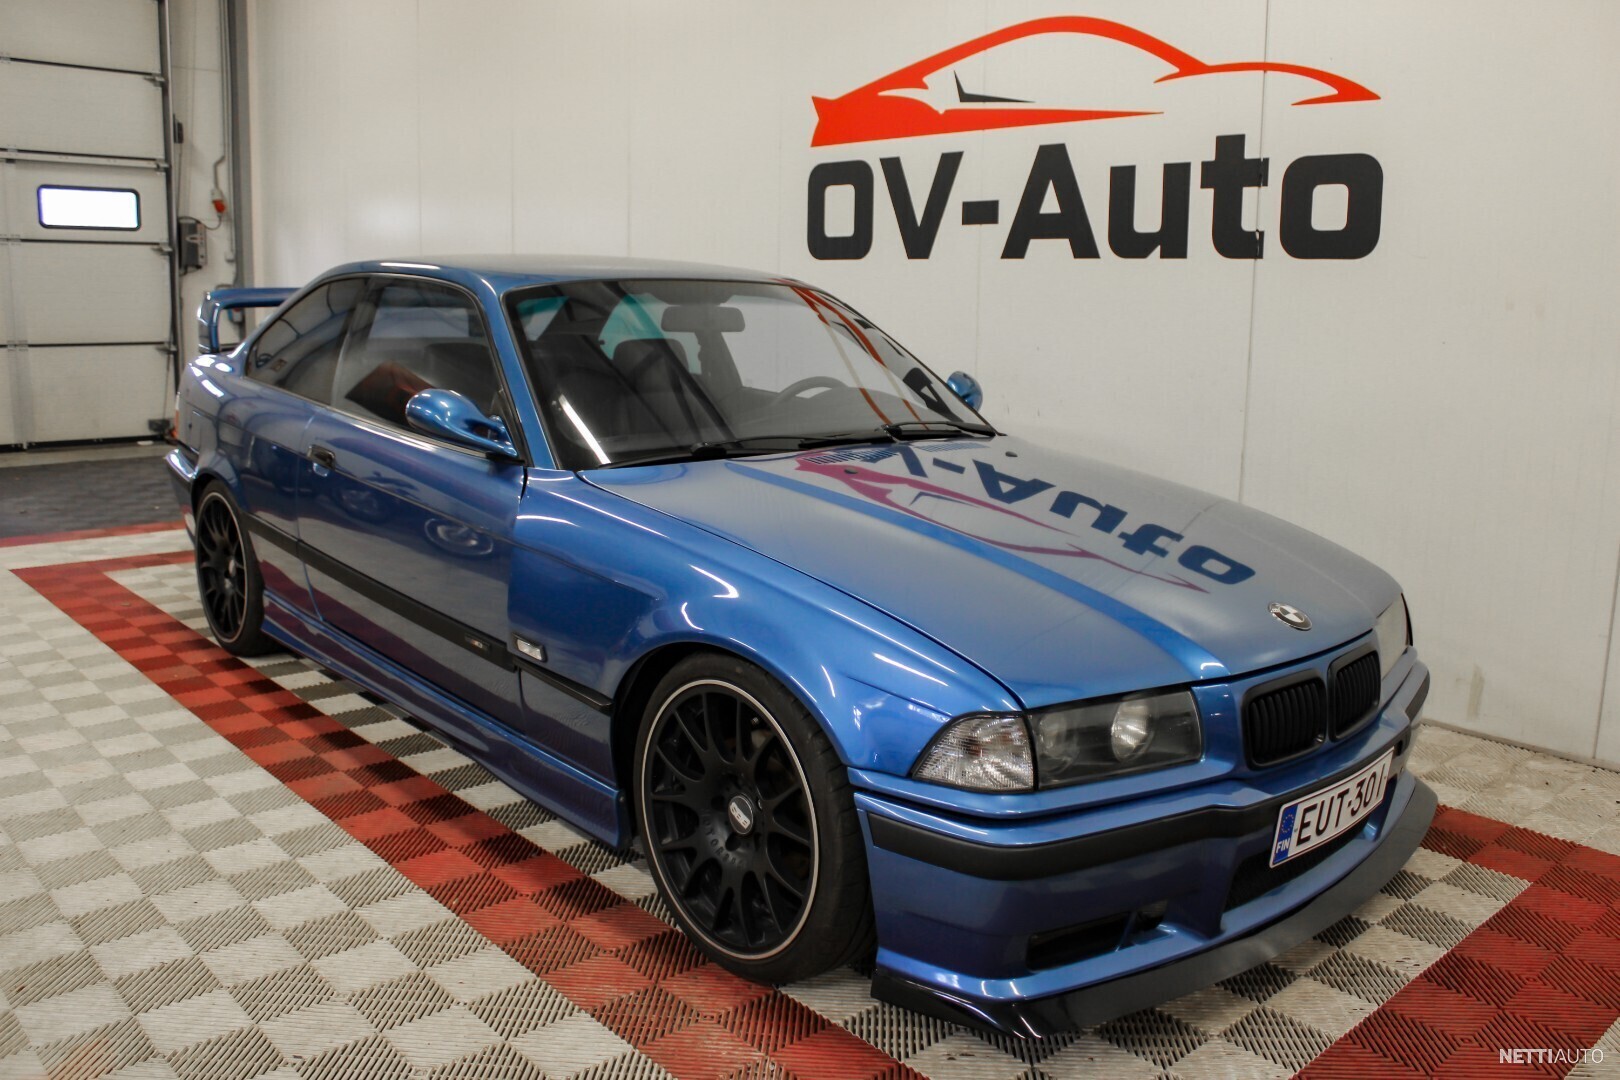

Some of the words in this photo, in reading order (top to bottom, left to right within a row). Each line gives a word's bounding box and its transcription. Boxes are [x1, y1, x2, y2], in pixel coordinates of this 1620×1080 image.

[807, 134, 1384, 260] OV-Auto
[1275, 837, 1292, 854] FIN
[1297, 763, 1385, 846] EUT-301
